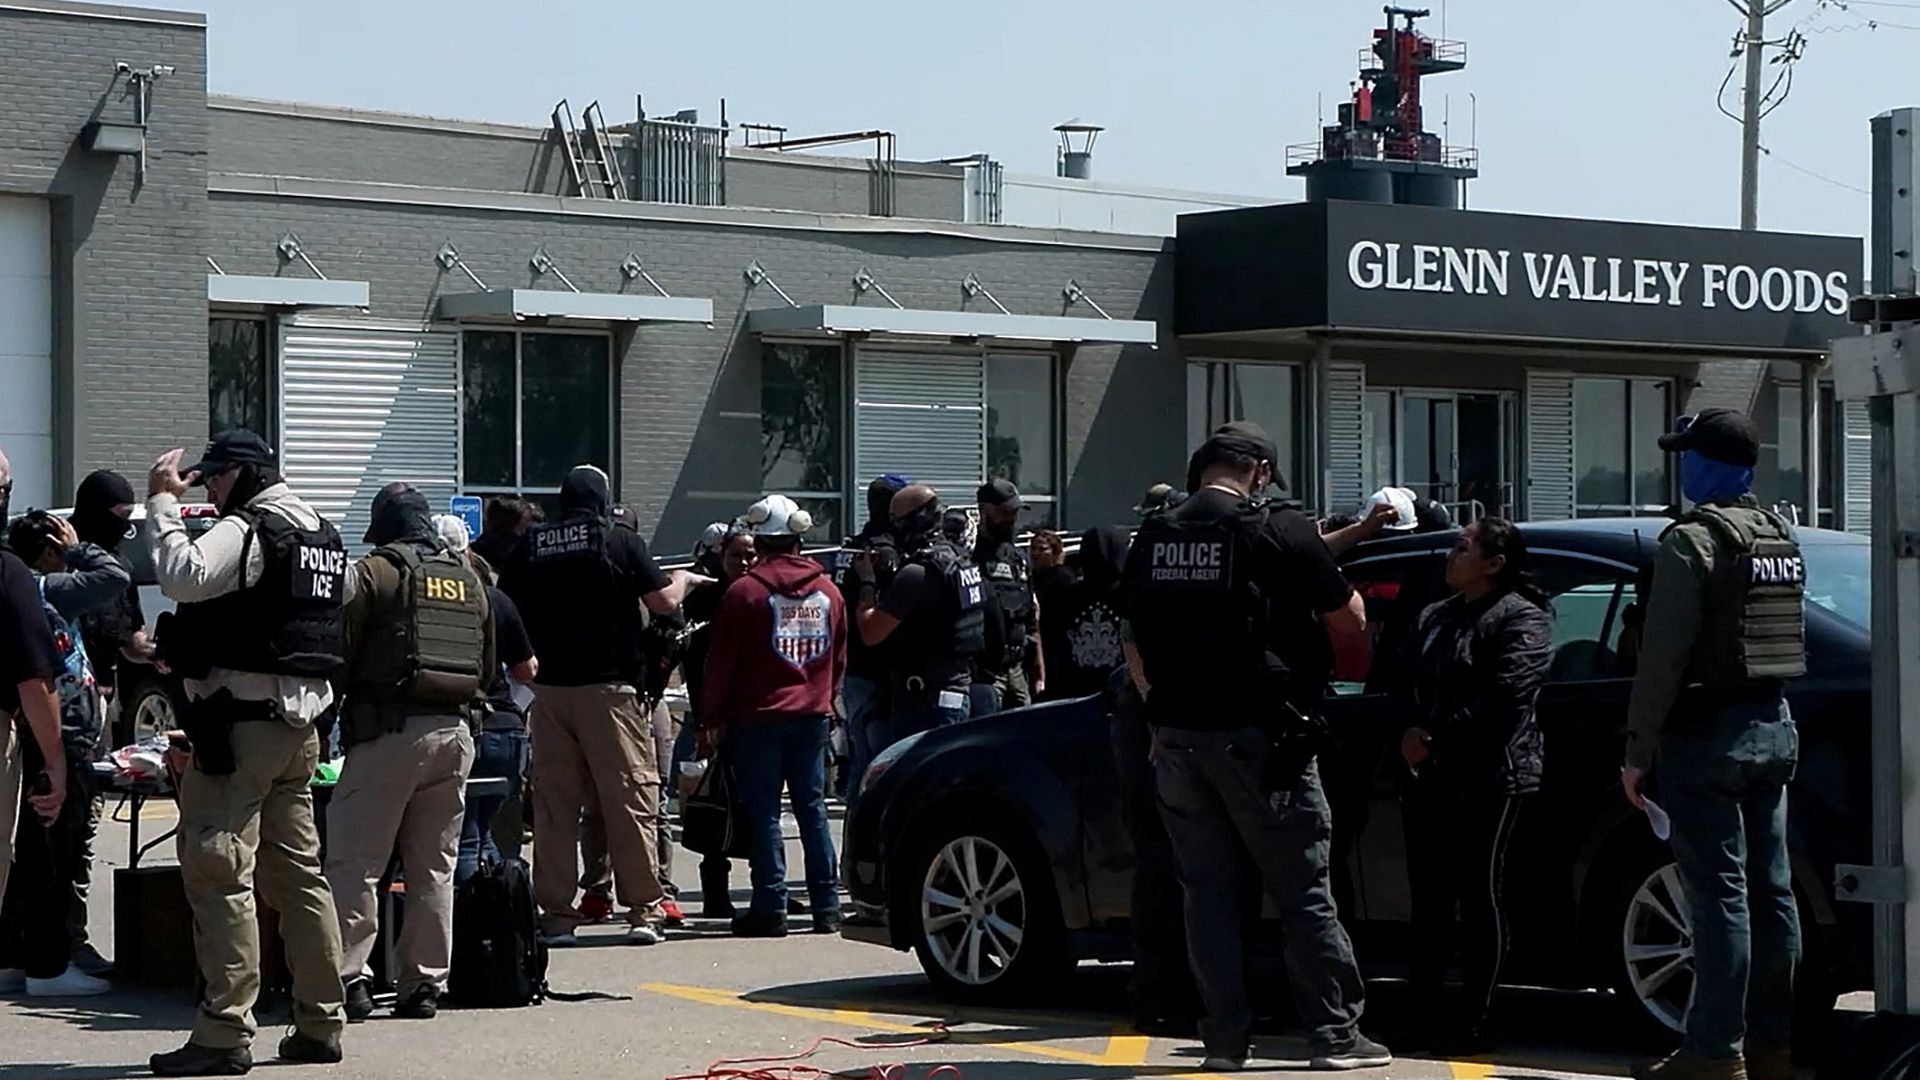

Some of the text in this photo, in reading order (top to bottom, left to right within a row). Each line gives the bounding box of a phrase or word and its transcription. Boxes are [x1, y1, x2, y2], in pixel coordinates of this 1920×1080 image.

[1348, 241, 1848, 315] GLENN VALLEY FOODS
[536, 524, 589, 547] POLICE
[300, 546, 344, 574] POLICE
[1152, 542, 1222, 566] POLICE
[1152, 568, 1220, 580] FEDERAL AGENT
[1752, 557, 1802, 582] POLICE
[312, 573, 333, 598] ICE
[427, 577, 466, 601] HSI
[798, 606, 821, 619] DAYS
